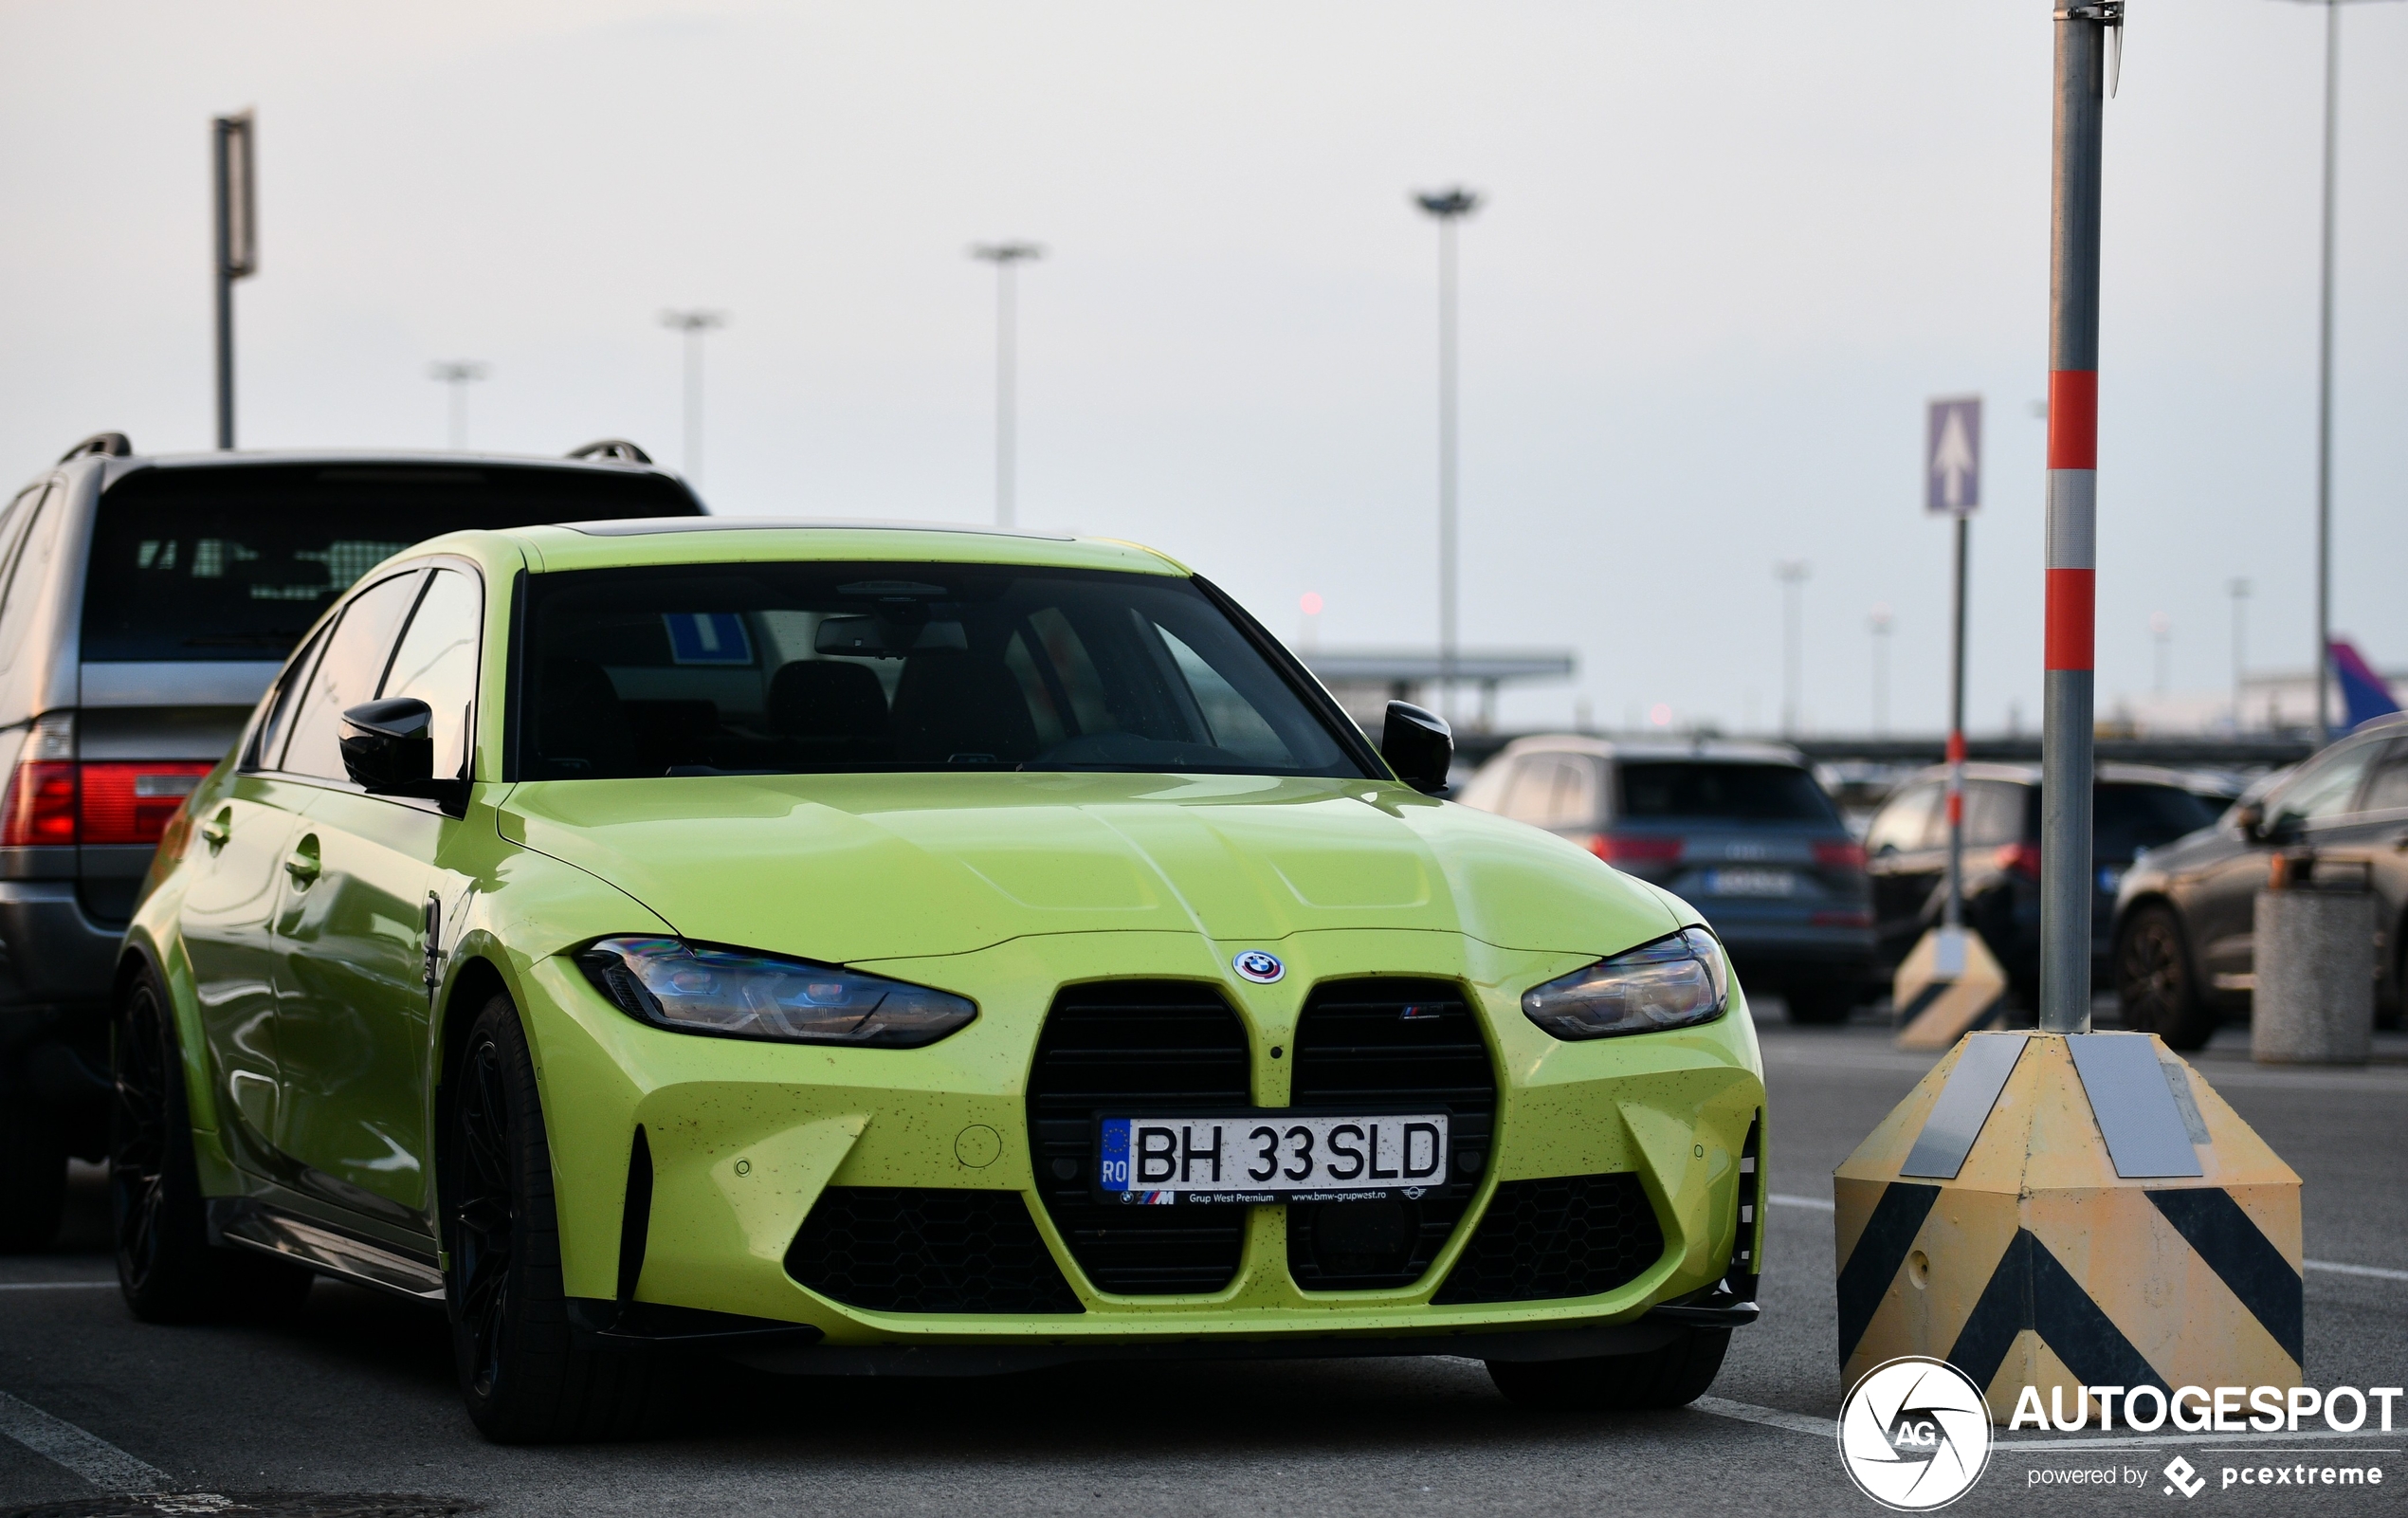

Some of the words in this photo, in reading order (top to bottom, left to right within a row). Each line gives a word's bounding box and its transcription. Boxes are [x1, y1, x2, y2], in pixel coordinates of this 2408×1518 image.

[1138, 1125, 1222, 1182] BH
[1248, 1125, 1314, 1181] 33
[1327, 1123, 1440, 1180] SLD
[1102, 1160, 1127, 1183] RO
[1189, 1193, 1212, 1204] Grup
[1213, 1193, 1233, 1203] West
[1236, 1193, 1274, 1202] Premium
[1291, 1191, 1387, 1202] www.bmw-grupwest.ro
